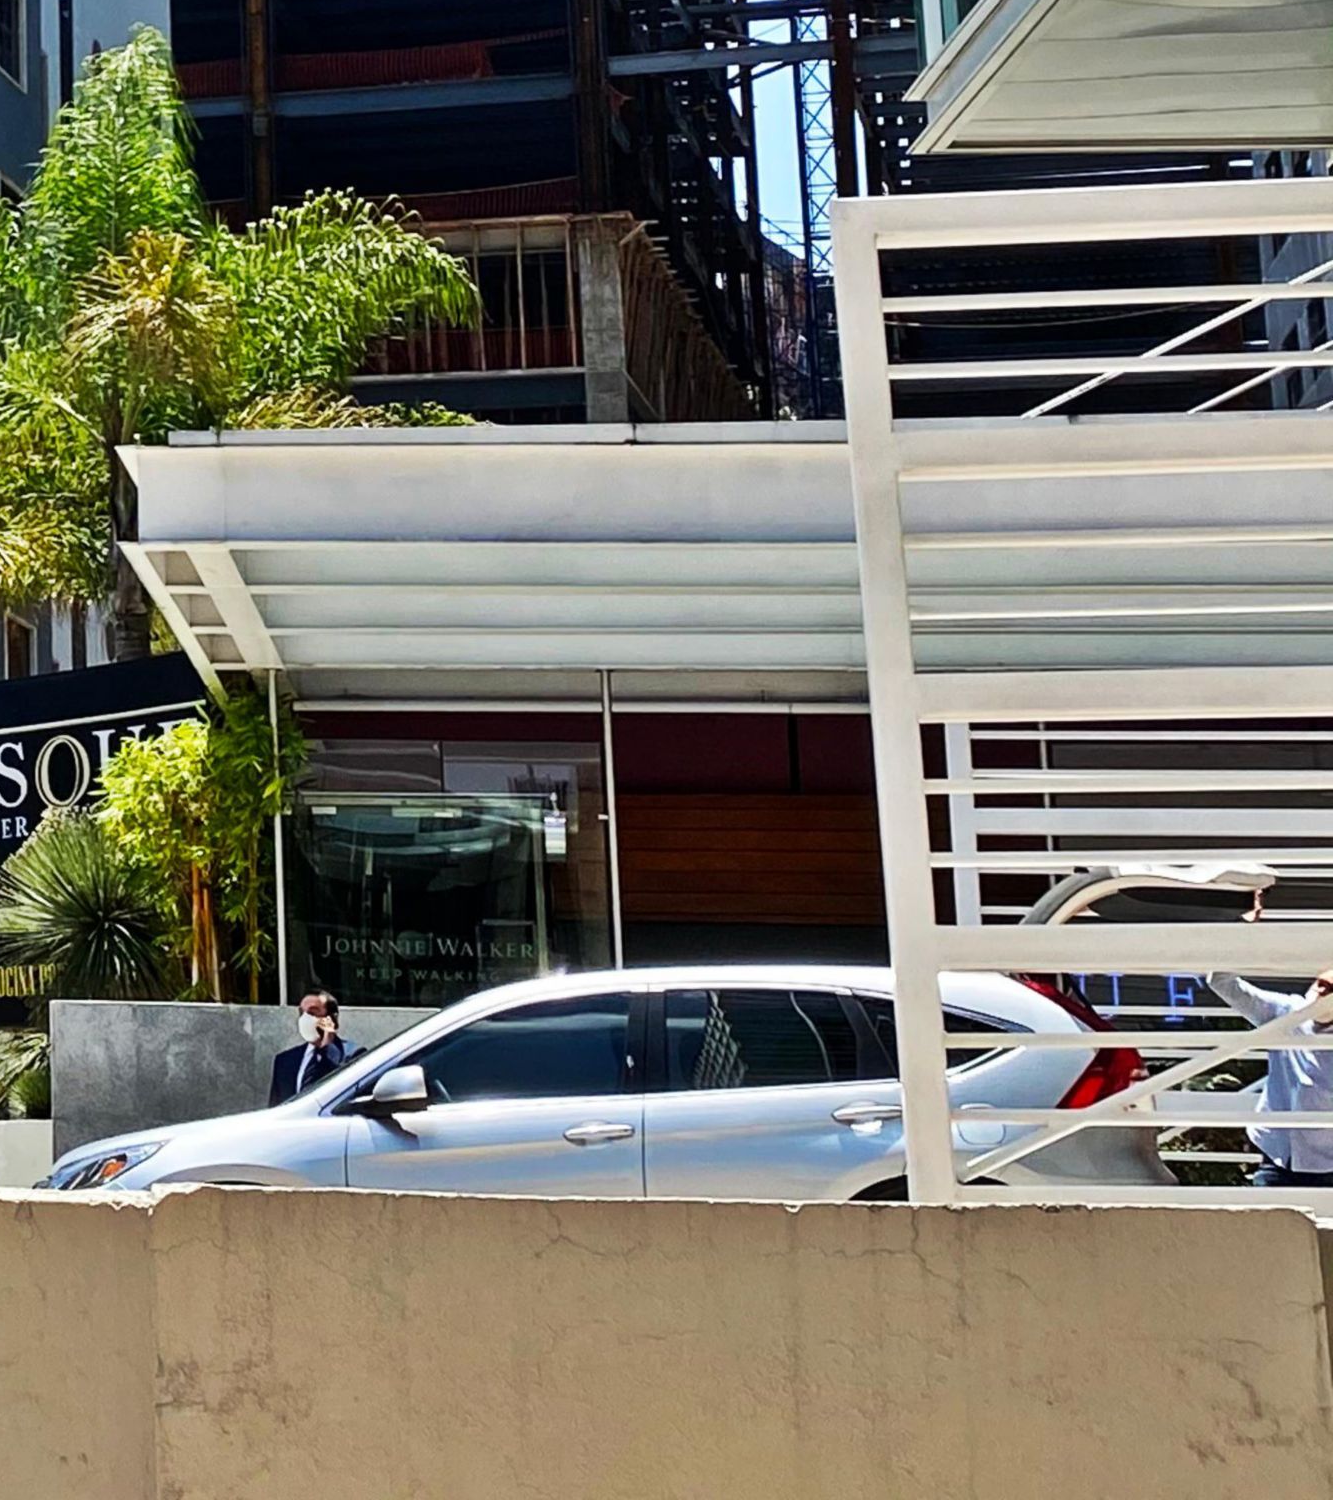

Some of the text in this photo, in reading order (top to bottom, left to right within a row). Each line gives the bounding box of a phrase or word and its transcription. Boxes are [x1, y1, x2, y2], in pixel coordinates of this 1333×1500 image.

[321, 934, 533, 959] JOHNNIE WALKER
[356, 967, 500, 983] KEEP WALKING
